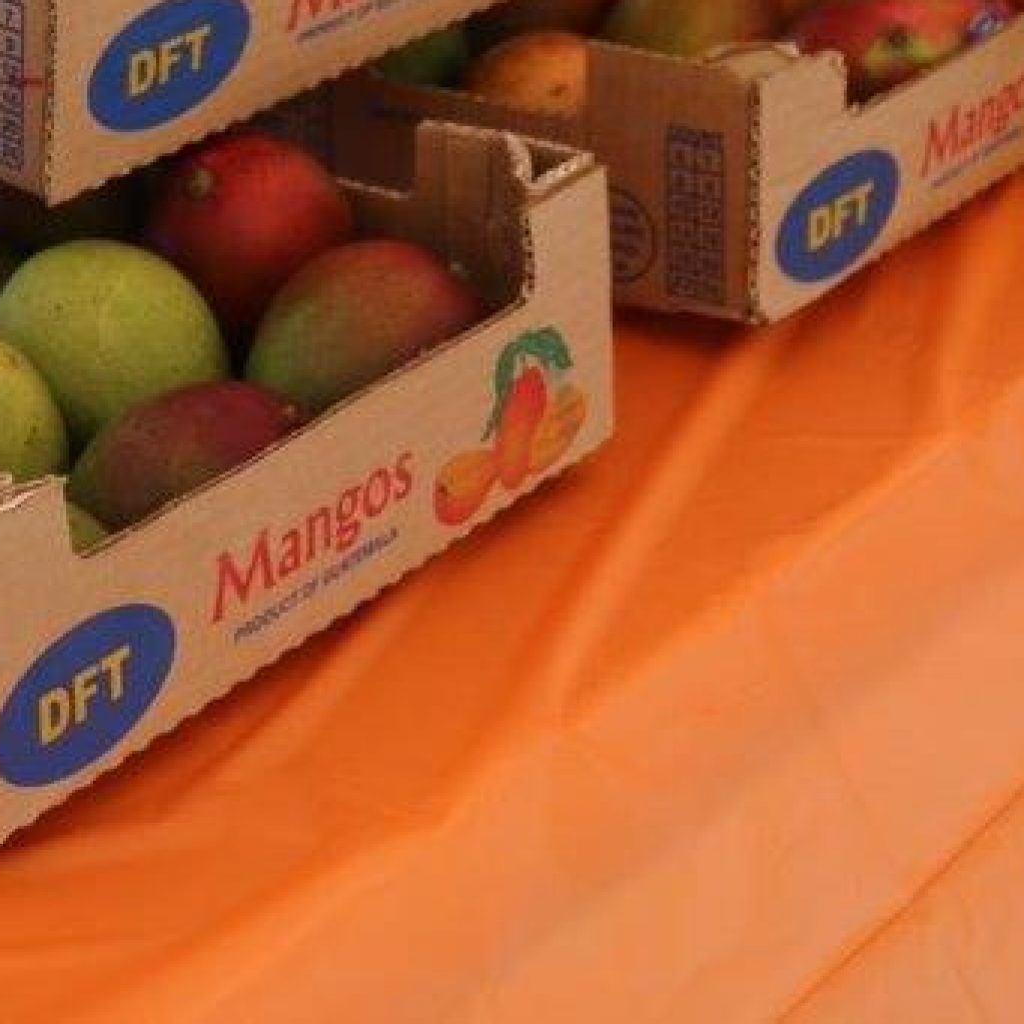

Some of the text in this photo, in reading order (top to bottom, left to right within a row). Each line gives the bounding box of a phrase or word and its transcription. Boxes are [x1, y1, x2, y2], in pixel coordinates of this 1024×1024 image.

[127, 24, 211, 99] DFT
[808, 183, 874, 252] DFT
[211, 450, 414, 625] Mangos
[37, 646, 131, 746] DFT
